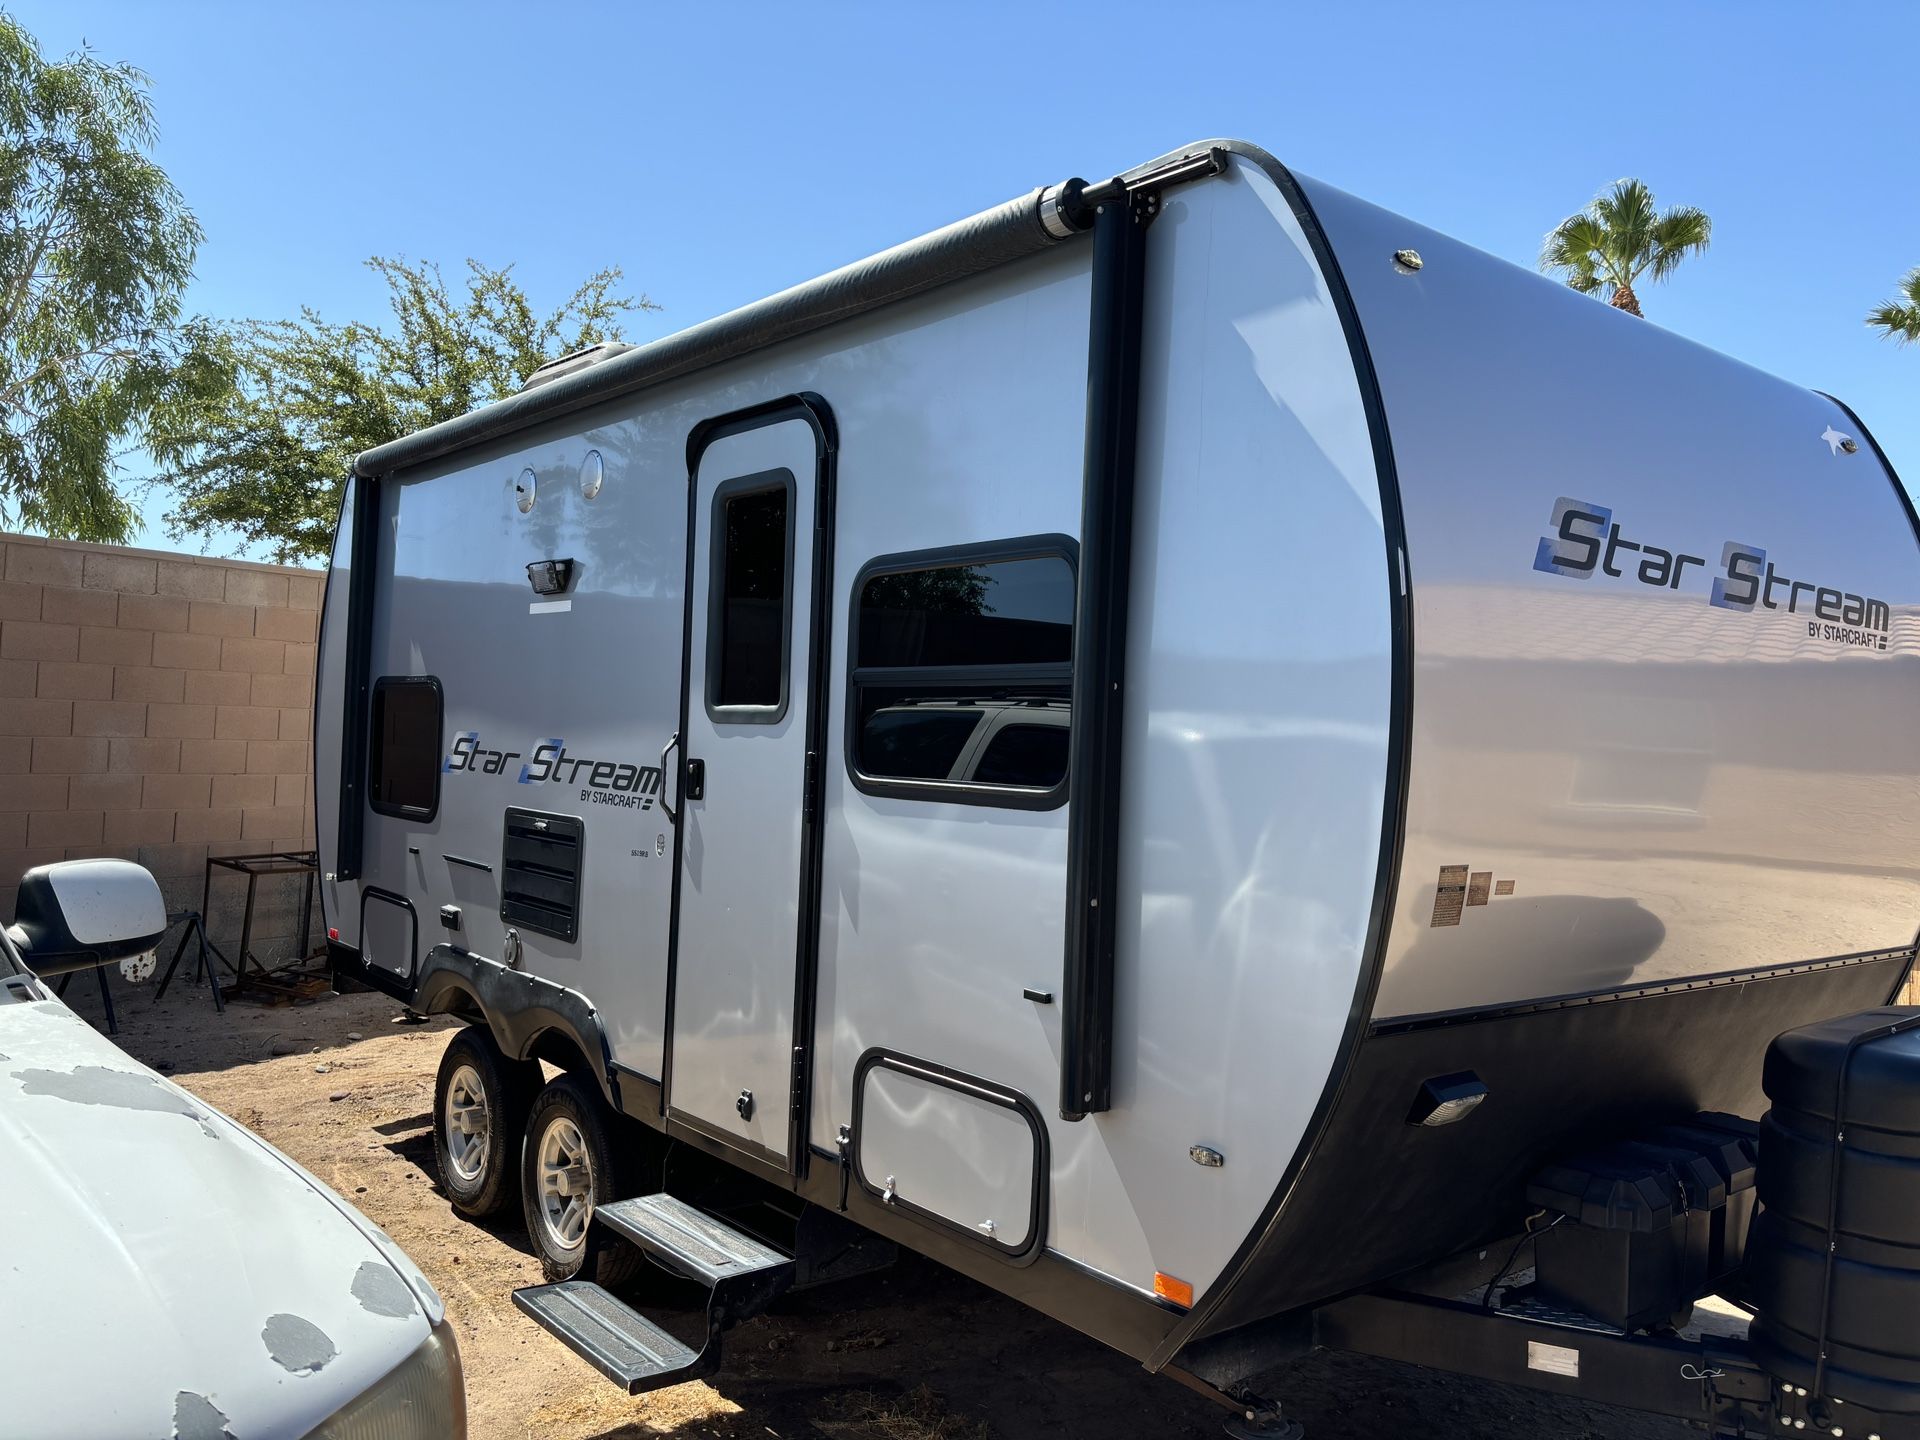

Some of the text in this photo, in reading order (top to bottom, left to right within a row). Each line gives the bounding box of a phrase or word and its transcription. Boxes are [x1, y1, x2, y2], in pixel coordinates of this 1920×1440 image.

[1551, 509, 1890, 632] Star Stream
[1808, 621, 1878, 649] BY STARCRAFT
[448, 737, 661, 795] Star Stream
[580, 789, 643, 810] BY STARCRAFT
